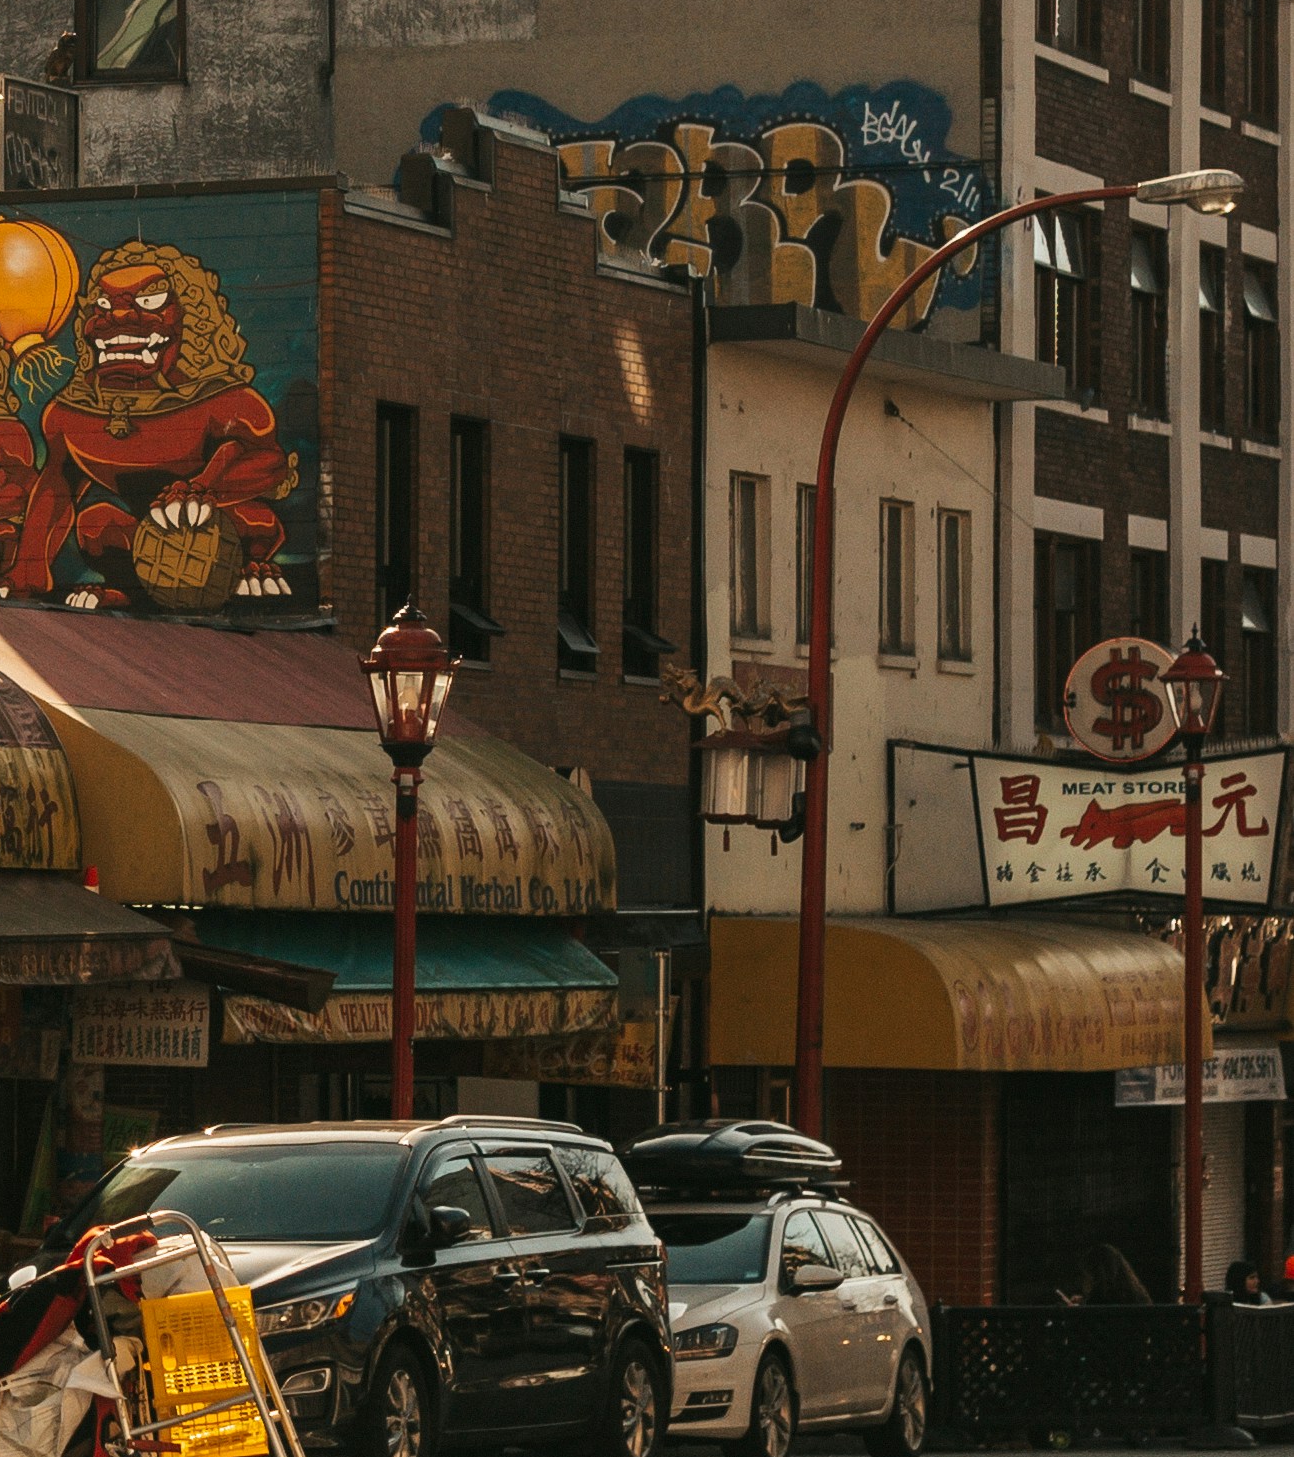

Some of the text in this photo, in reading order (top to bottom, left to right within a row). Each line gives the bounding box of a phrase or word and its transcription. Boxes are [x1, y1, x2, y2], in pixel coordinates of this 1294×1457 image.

[1062, 781, 1188, 795] MEAT STORE
[460, 875, 523, 910] Herbal
